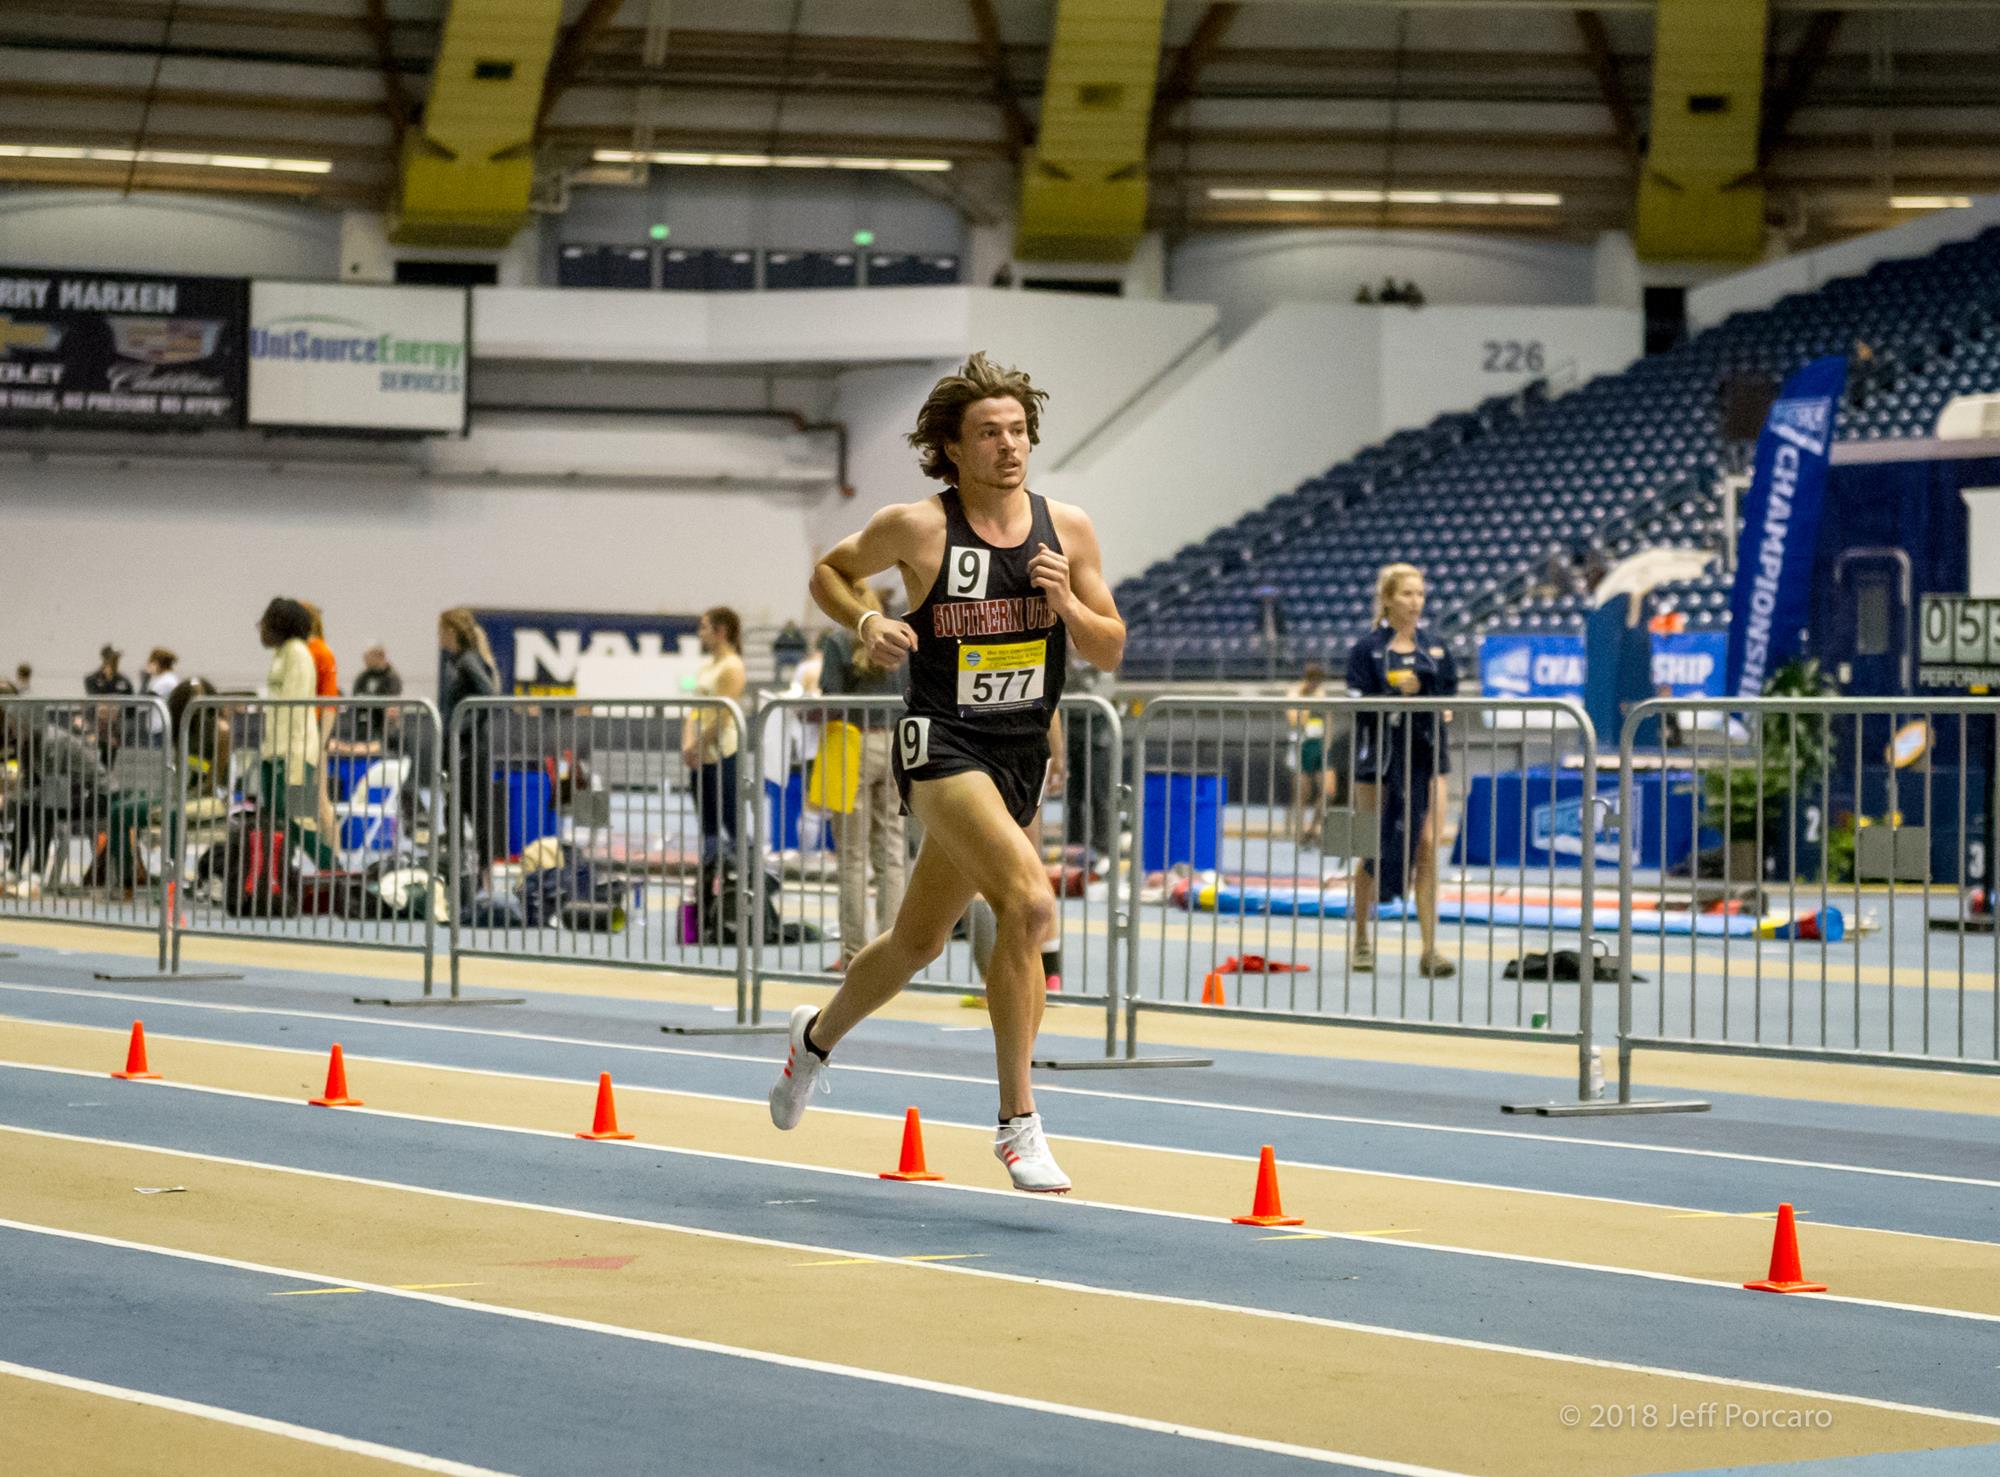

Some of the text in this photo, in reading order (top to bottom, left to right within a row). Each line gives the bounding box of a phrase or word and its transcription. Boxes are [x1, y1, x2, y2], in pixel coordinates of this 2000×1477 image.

[60, 283, 177, 314] MARXEN
[1482, 340, 1545, 372] 226
[957, 550, 981, 594] 9
[1738, 443, 1799, 702] CHAMPIONSHI
[933, 599, 1025, 638] SOUTHERN
[972, 669, 1036, 703] 577
[904, 720, 920, 766] 9
[1806, 806, 1821, 842] 2
[1968, 841, 1985, 878] 3
